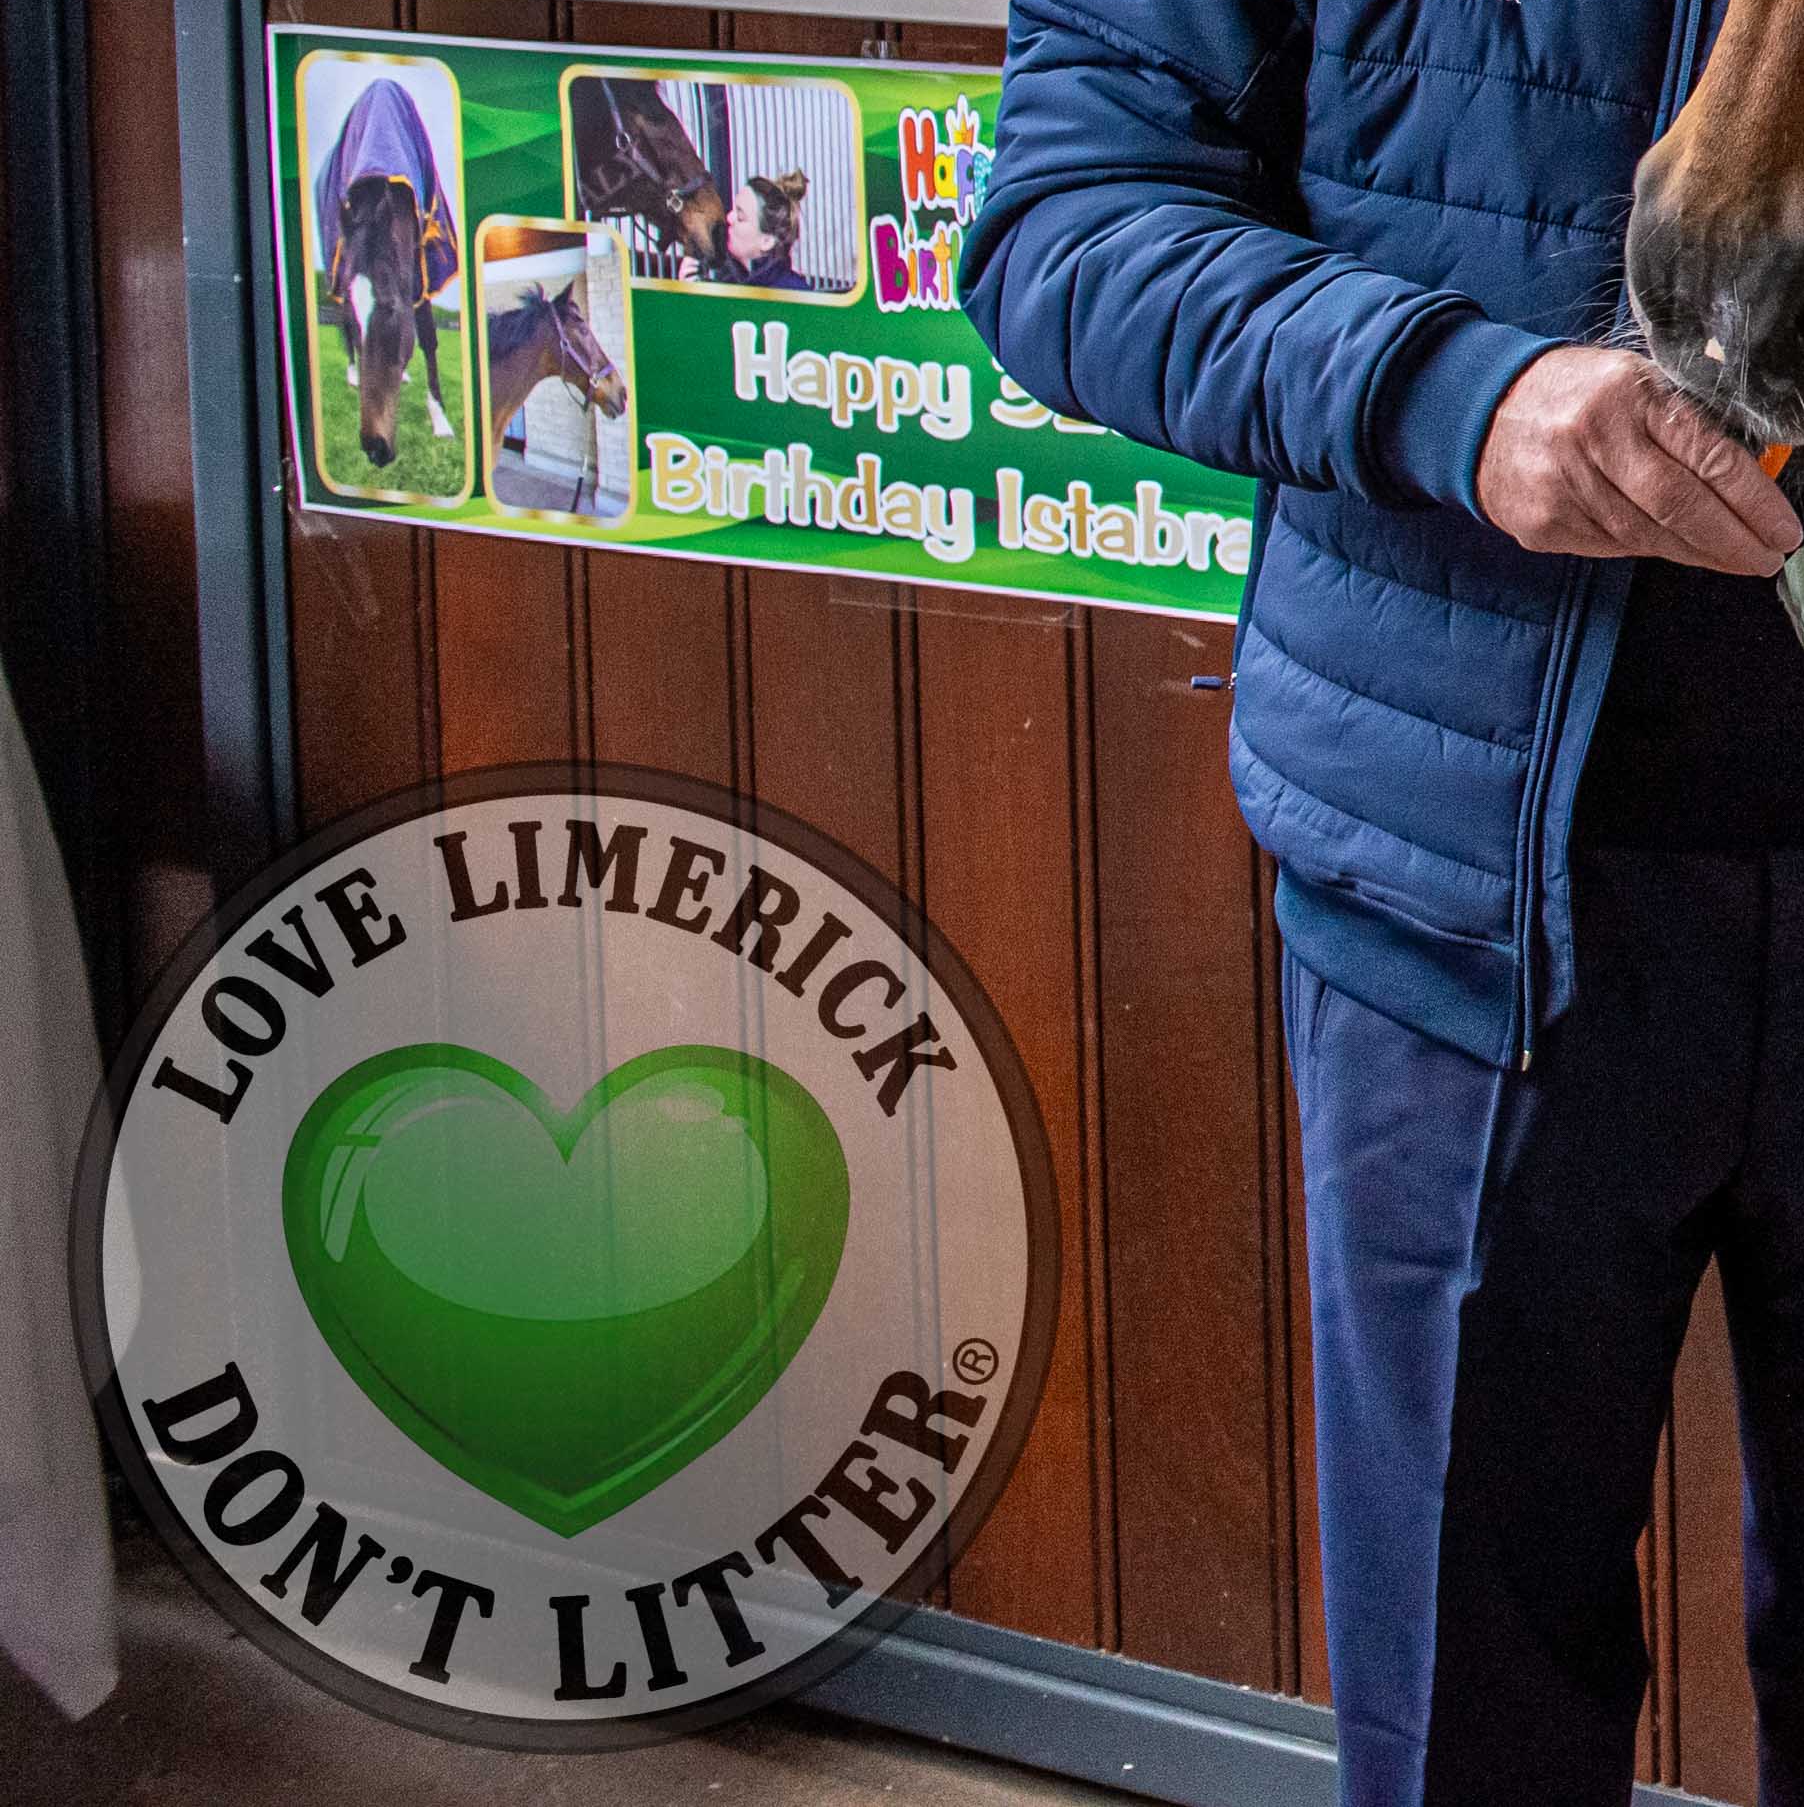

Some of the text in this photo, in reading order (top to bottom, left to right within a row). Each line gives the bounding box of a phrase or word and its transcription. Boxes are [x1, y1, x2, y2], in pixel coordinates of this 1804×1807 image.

[732, 321, 971, 440] Happy
[644, 431, 1253, 575] Birthday Istabra
